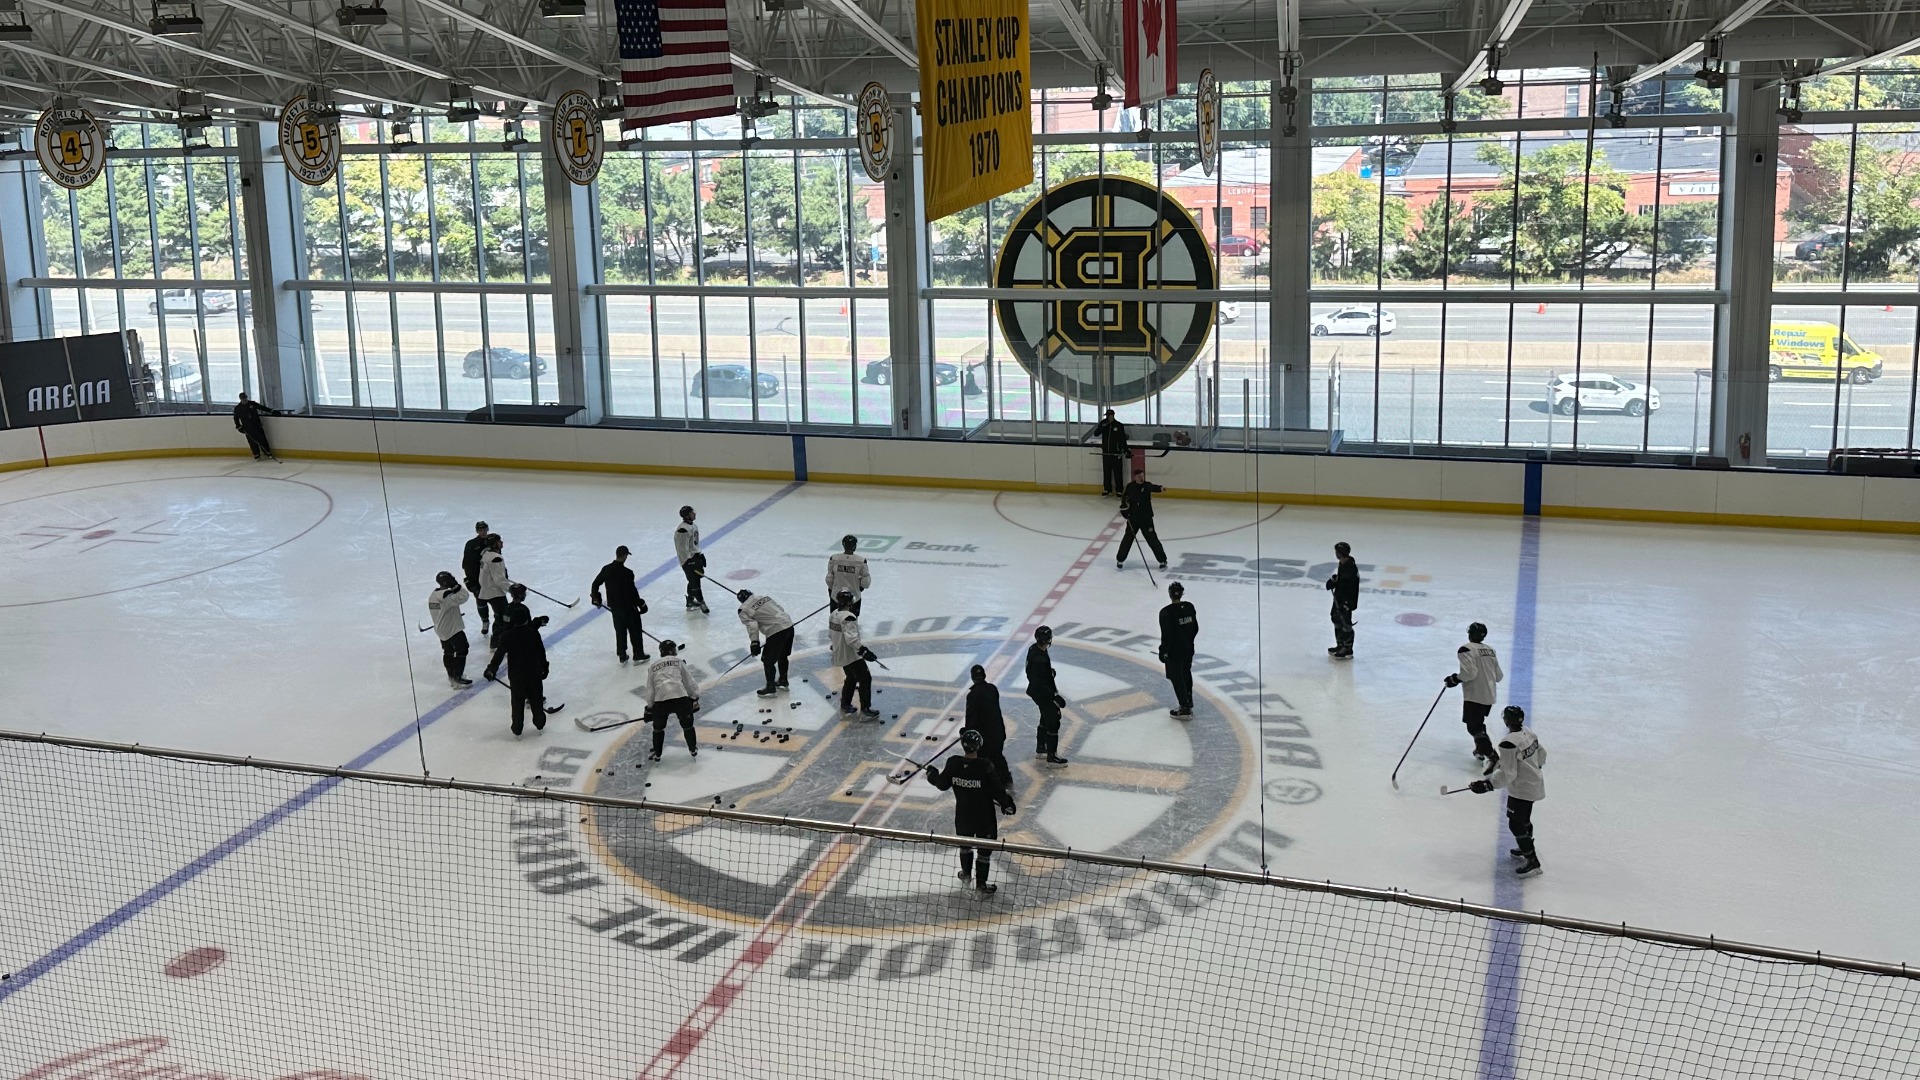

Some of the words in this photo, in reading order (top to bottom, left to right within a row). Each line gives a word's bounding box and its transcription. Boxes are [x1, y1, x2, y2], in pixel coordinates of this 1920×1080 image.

[935, 17, 992, 67] STANLEY
[996, 16, 1020, 60] CUP
[937, 70, 1023, 127] CHAMPIONS
[283, 104, 299, 146] AUBREY
[873, 121, 881, 144] 8
[65, 136, 78, 157] 4
[305, 130, 318, 151] 5
[574, 127, 583, 148] 7
[969, 128, 1000, 178] 1970
[56, 166, 96, 185] 1966-1976
[299, 159, 334, 180] 1927-1947
[1773, 329, 1807, 338] Repair
[1777, 339, 1825, 348] Windows
[28, 379, 111, 412] ARENA
[904, 540, 980, 553] Bank
[1165, 574, 1257, 586] ELECTRIC
[1262, 580, 1327, 591] SUPPL
[1359, 587, 1429, 598] ENTER
[951, 776, 982, 788] PEDERSON
